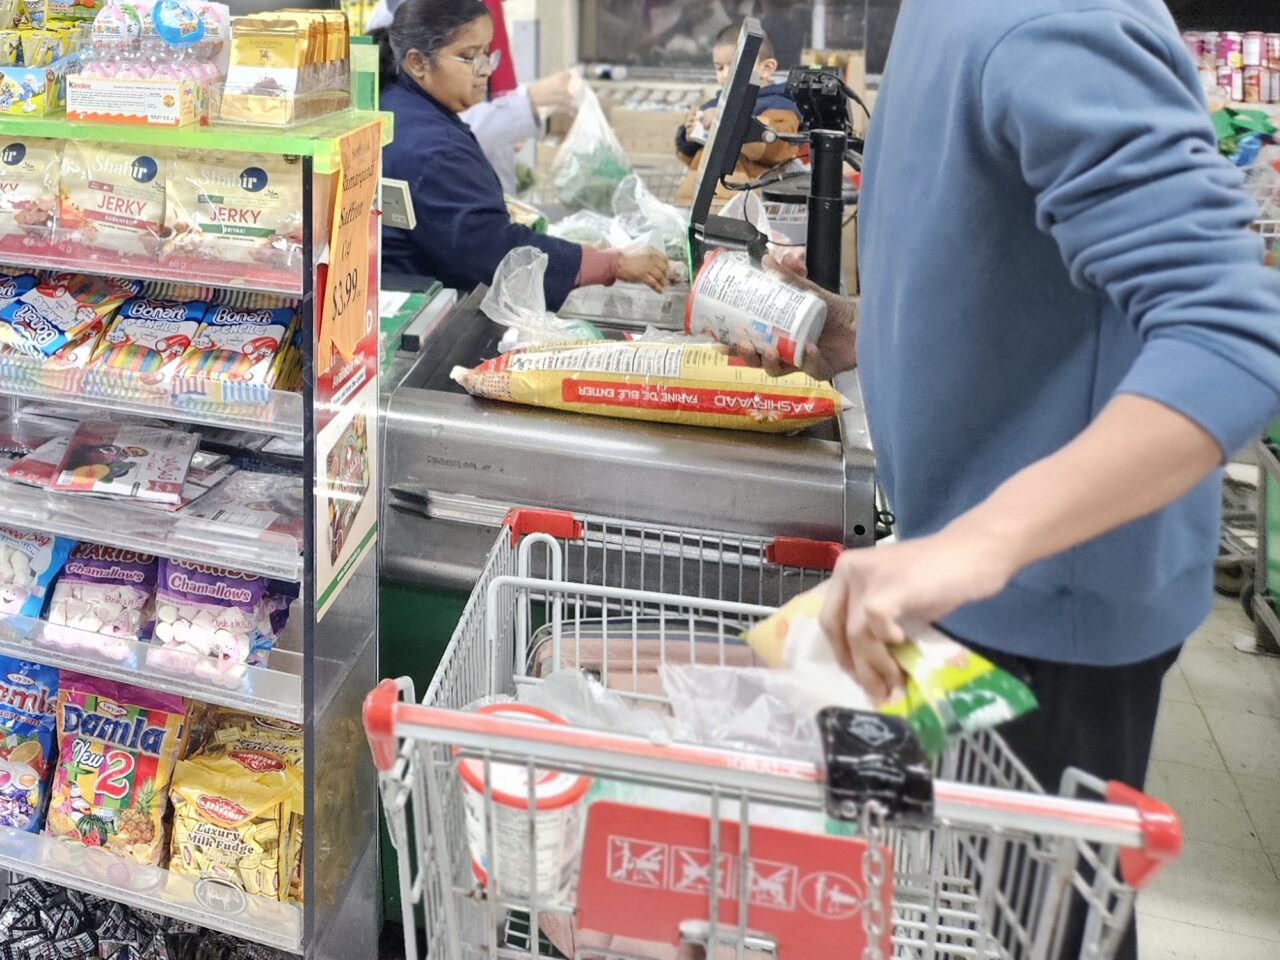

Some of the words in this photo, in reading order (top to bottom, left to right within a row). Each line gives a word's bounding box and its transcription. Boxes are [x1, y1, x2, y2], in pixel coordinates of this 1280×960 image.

[69, 81, 91, 90] Kinder
[97, 193, 148, 218] JERKY
[210, 207, 262, 224] JERKY
[339, 201, 363, 228] Saffron
[129, 302, 187, 320] Bonart
[213, 308, 273, 325] Bonart
[13, 304, 58, 346] Bonart
[578, 386, 616, 398] ENTIER
[661, 392, 698, 404] FARINE
[714, 394, 815, 414] AASHIRVAAD
[66, 562, 143, 582] Chamallows
[170, 575, 252, 602] Chamallows
[62, 704, 166, 755] Damla
[72, 740, 104, 768] New
[94, 750, 135, 799] 2
[197, 823, 240, 840] Luxury
[187, 833, 215, 847] Milk
[216, 839, 254, 855] Fudge
